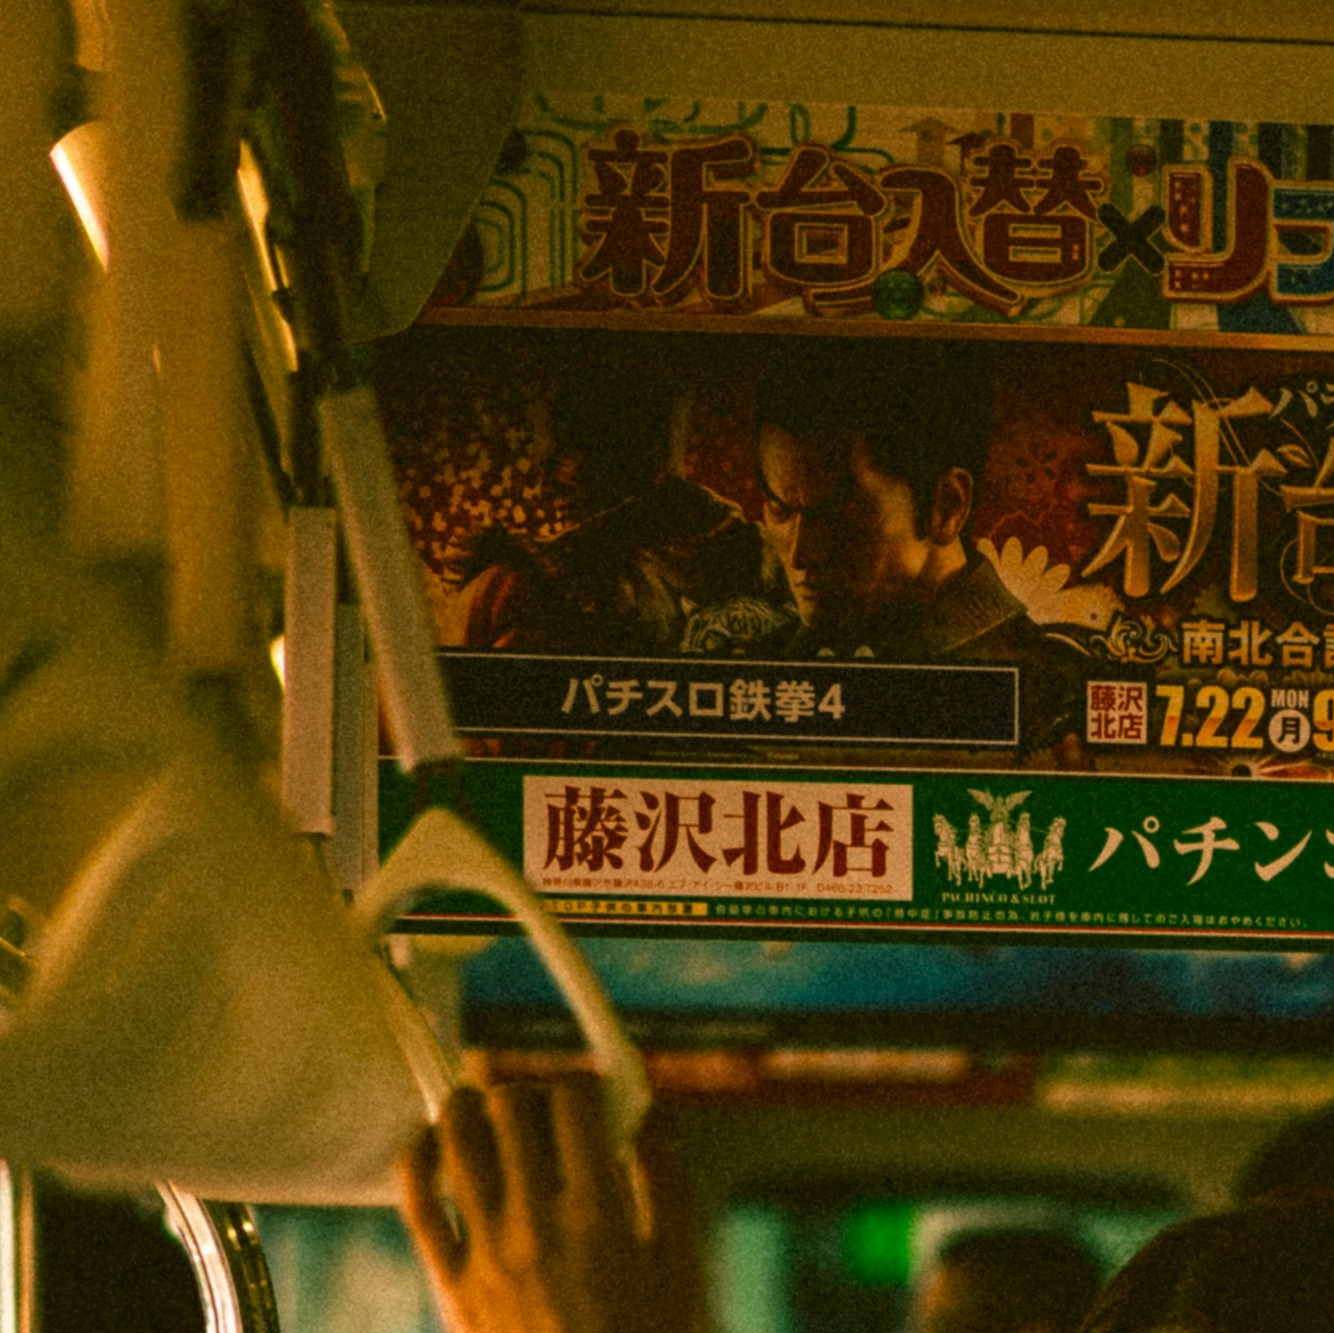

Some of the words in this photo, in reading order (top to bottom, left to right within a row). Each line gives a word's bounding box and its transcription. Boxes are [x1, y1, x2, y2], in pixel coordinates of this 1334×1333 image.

[560, 674, 845, 721] パチスロ鉄拳4
[1090, 685, 1144, 713] 藤沢
[1271, 688, 1310, 709] MON
[1090, 712, 1143, 740] 北店
[1155, 684, 1266, 749] 7.22
[1280, 716, 1299, 745] 月
[543, 786, 894, 877] 藤沢北店
